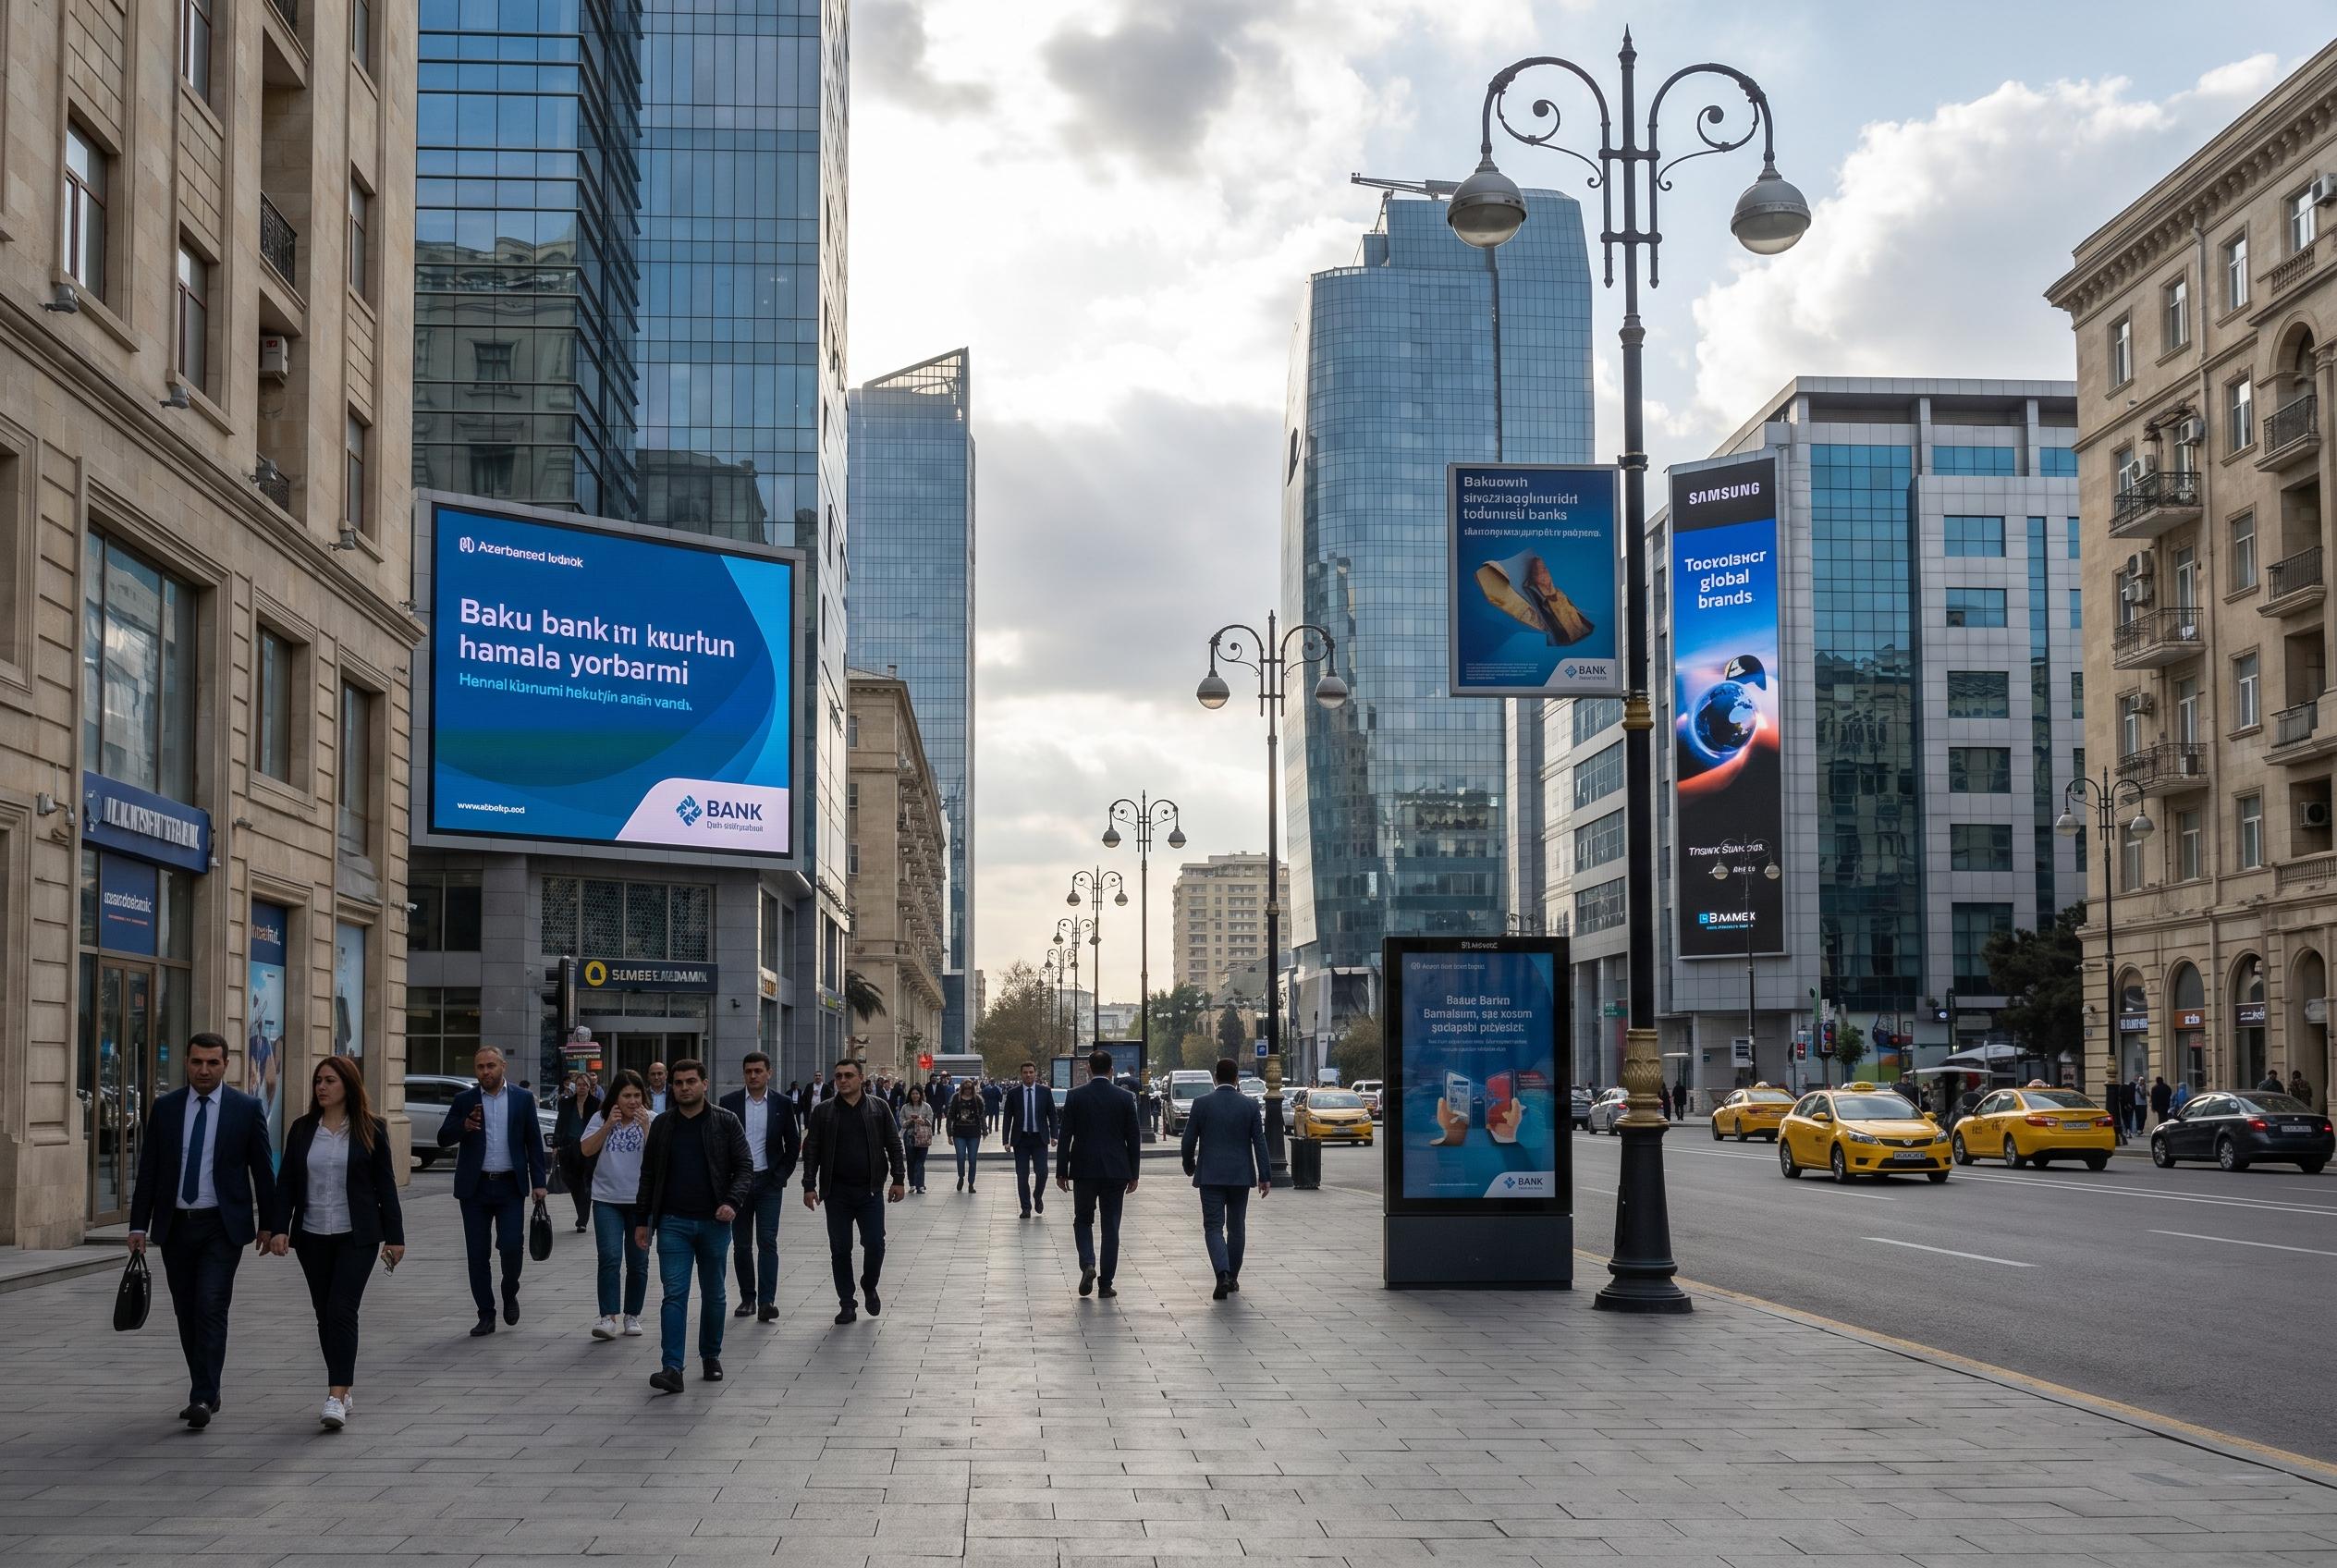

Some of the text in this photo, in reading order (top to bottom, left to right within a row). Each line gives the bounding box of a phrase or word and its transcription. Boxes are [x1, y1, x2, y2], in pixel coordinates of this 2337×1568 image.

[1689, 482, 1760, 505] SAMSUNG
[1529, 508, 1567, 520] banks
[1700, 569, 1749, 593] global
[460, 597, 532, 632] Baku
[543, 608, 609, 642] bank
[459, 634, 689, 686] hamala yorbarmi
[1579, 666, 1607, 675] BANK
[459, 673, 508, 691] Hennal
[707, 801, 763, 821] BANK
